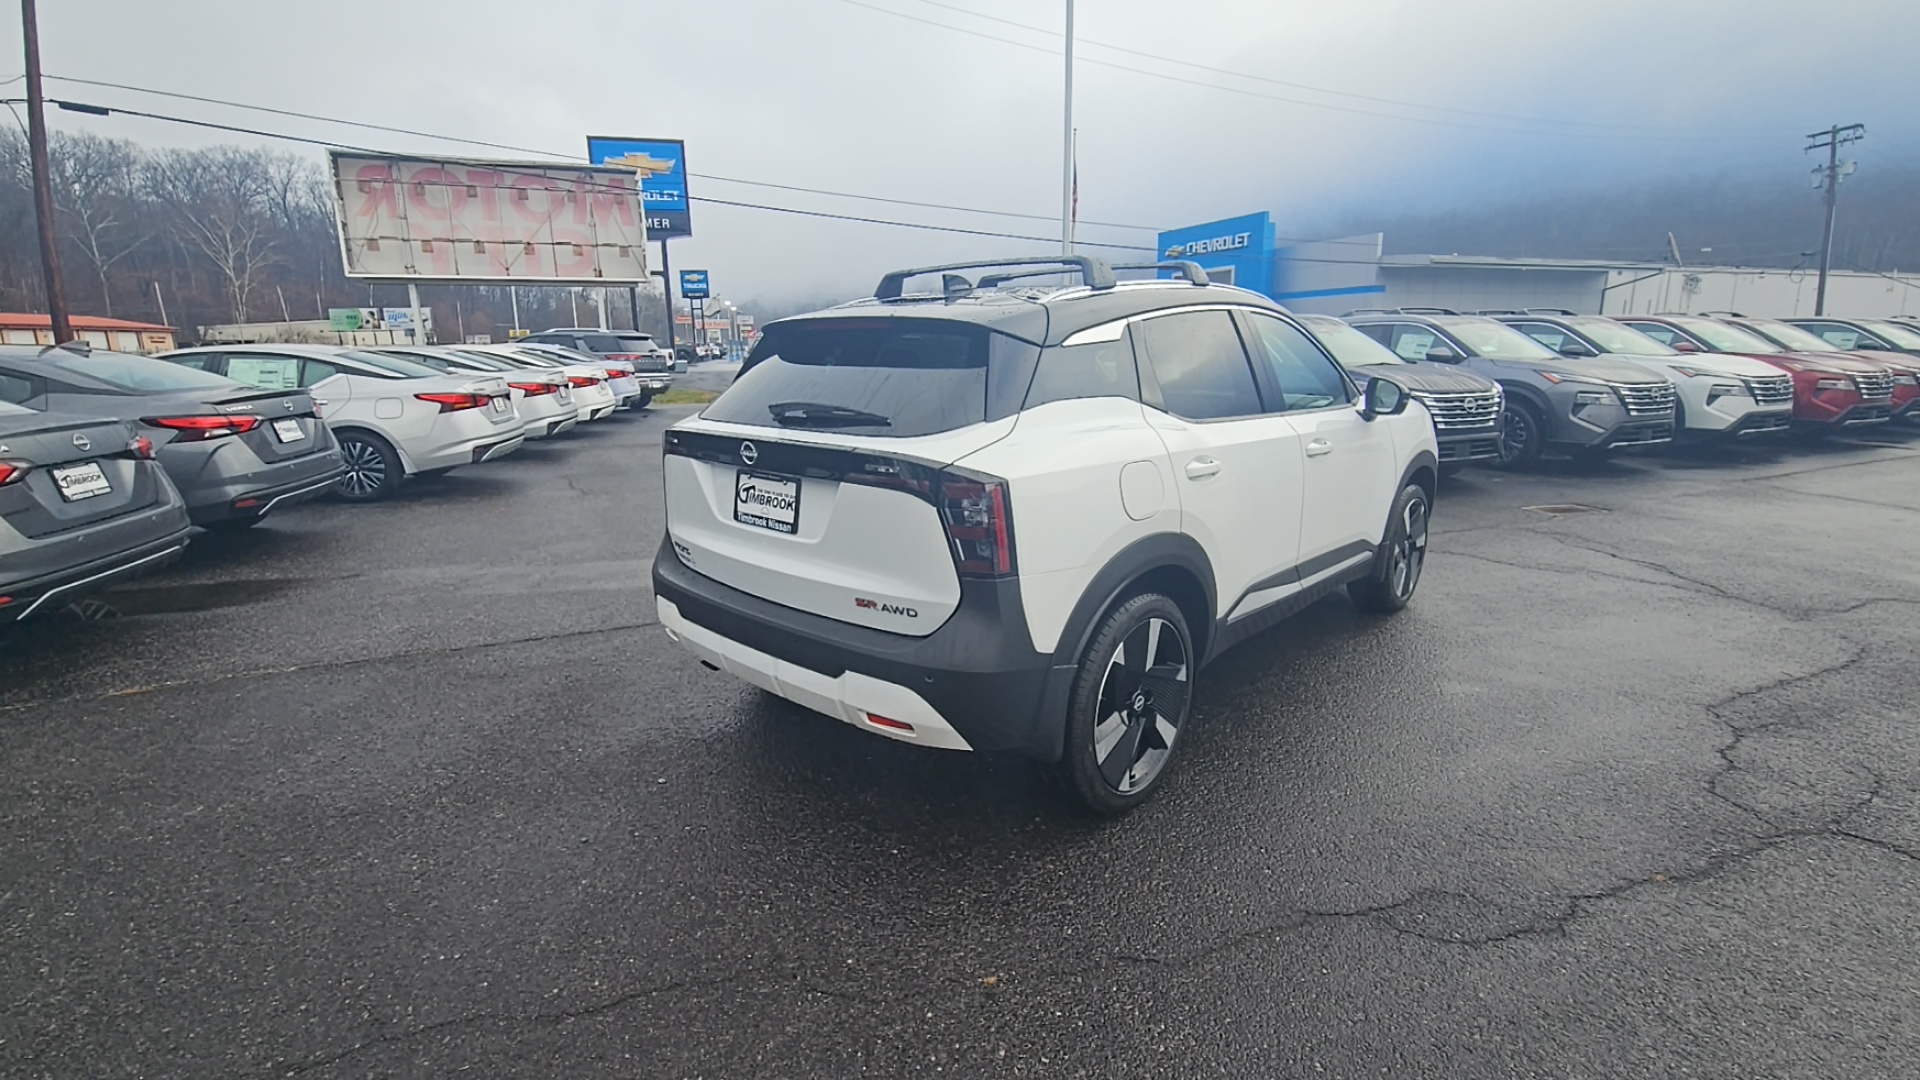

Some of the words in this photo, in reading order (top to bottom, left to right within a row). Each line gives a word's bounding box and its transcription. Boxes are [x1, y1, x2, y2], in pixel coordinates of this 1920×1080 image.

[1186, 232, 1251, 256] CHEVROLET
[738, 483, 796, 512] TIMBROOK
[737, 512, 767, 527] Timbrook
[768, 519, 792, 533] Nissan
[881, 603, 918, 618] AWD
